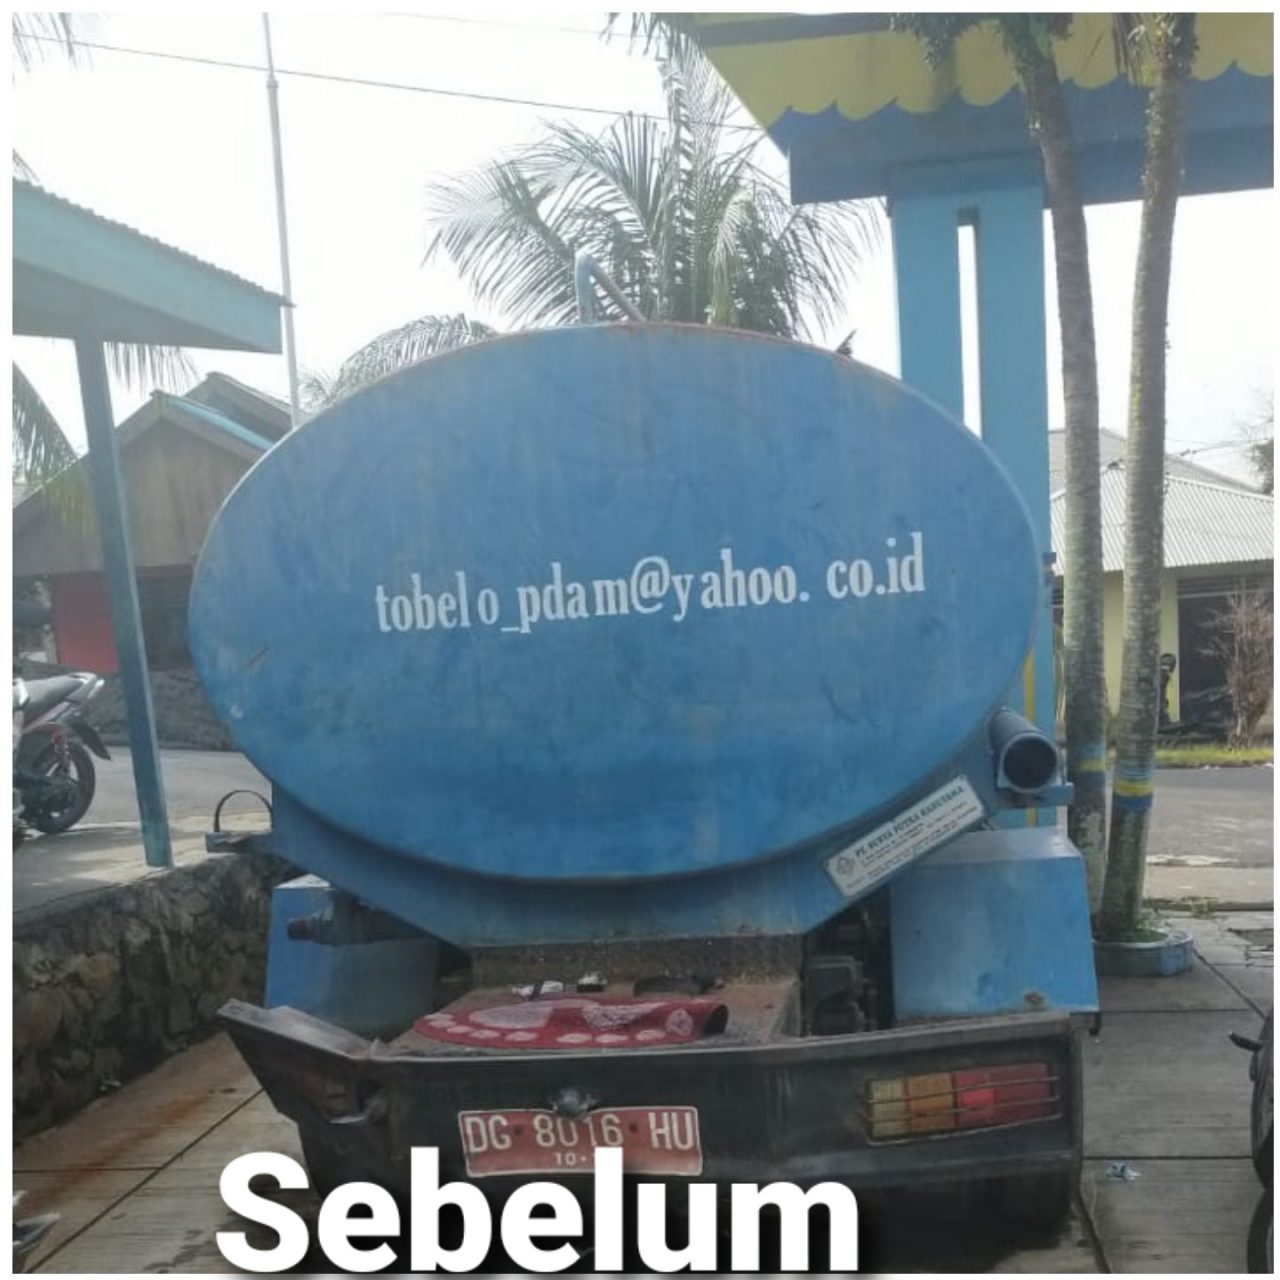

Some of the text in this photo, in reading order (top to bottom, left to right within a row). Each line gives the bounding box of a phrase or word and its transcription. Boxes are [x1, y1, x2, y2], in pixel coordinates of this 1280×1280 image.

[463, 1111, 695, 1152] DG 8016 HU
